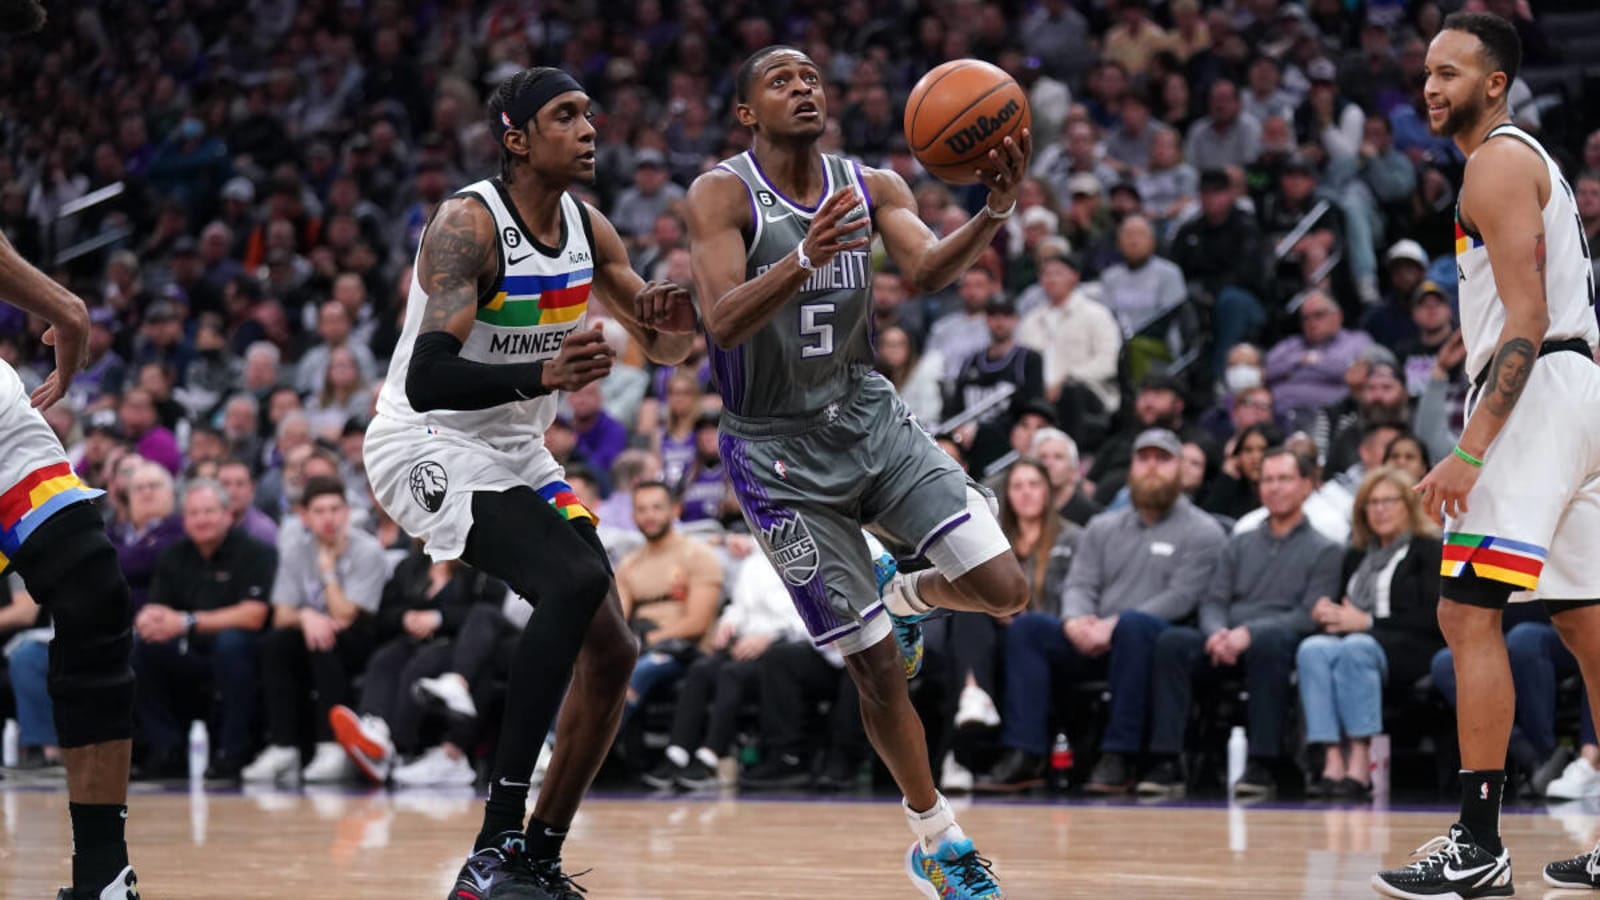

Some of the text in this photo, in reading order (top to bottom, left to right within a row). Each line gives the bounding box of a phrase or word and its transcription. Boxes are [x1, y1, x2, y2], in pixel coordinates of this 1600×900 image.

[944, 98, 1019, 154] Wilson
[503, 228, 519, 247] 6
[489, 325, 578, 355] MINNES
[800, 303, 835, 359] 5
